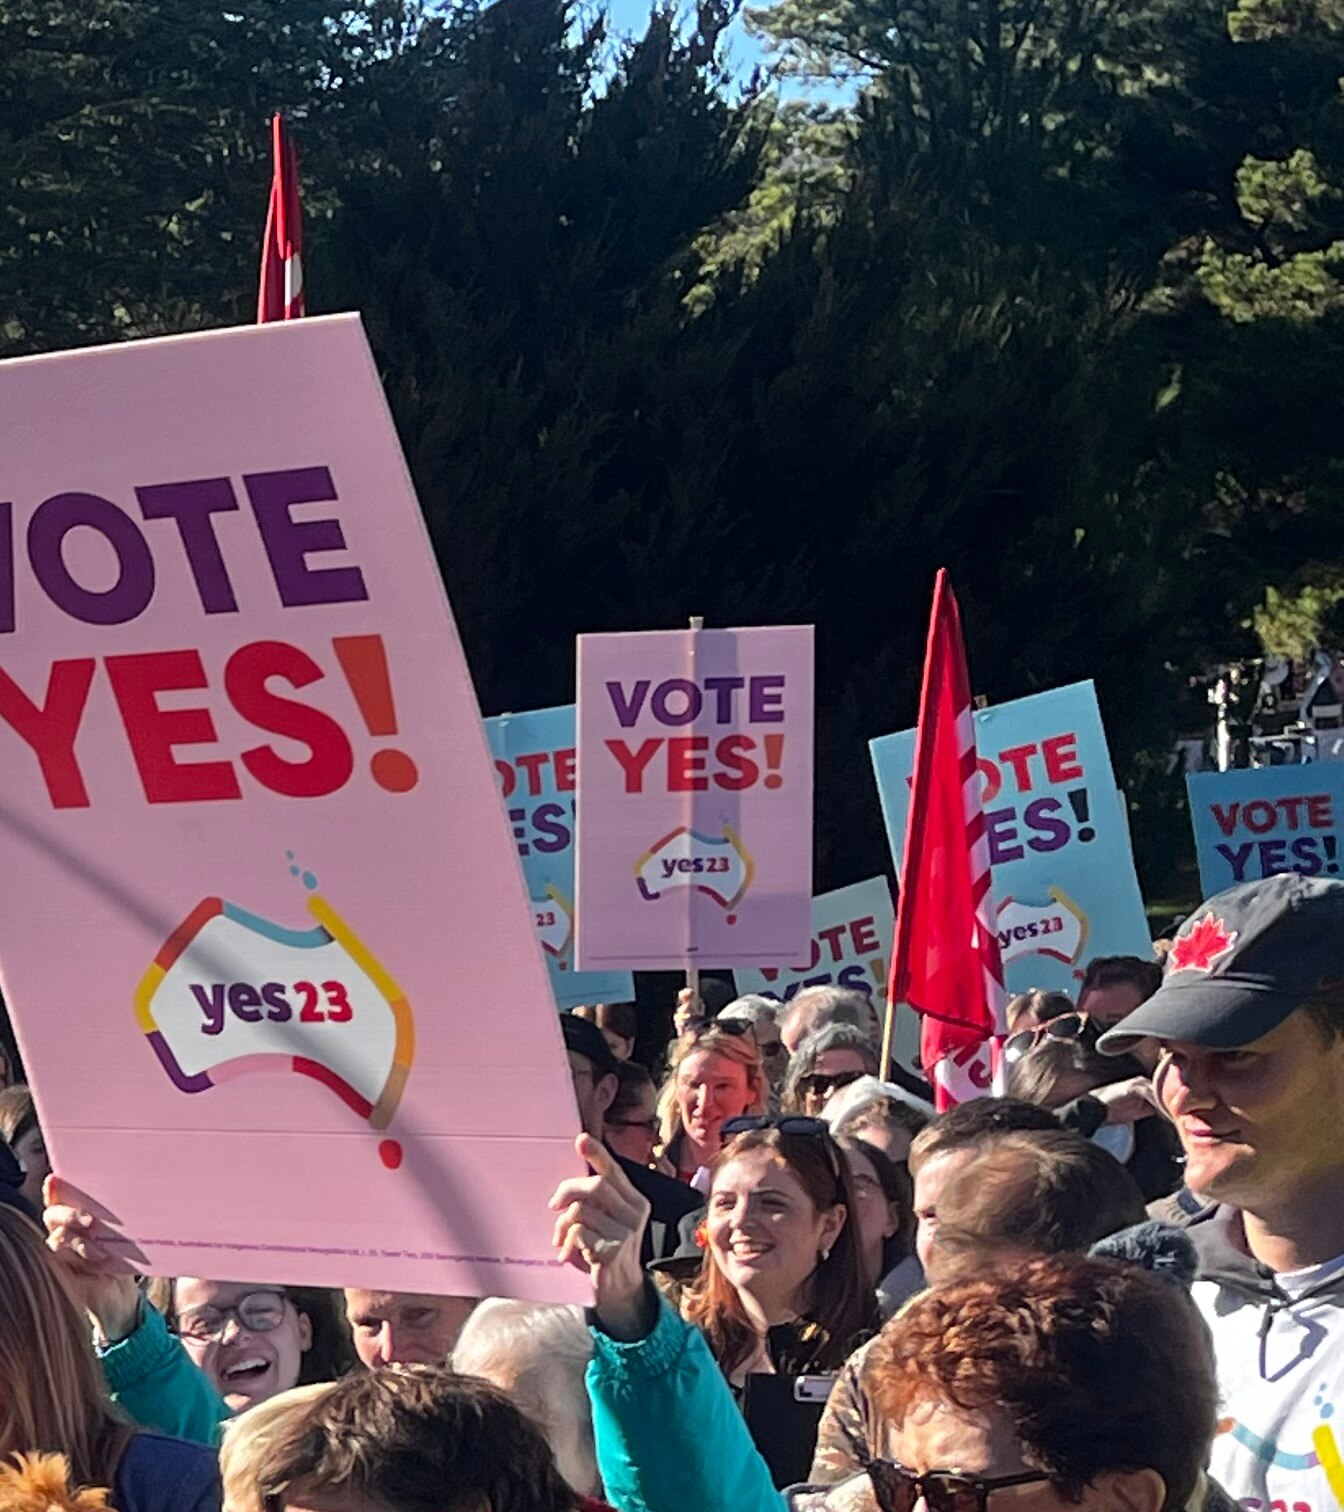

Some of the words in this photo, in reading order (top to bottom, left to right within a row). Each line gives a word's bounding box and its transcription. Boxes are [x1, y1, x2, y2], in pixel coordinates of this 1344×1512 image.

[605, 675, 785, 727] VOTE
[603, 734, 784, 793] YES!
[985, 788, 1095, 865] ES!
[1210, 794, 1333, 836] VOTE
[1215, 836, 1339, 881] YES!
[189, 979, 352, 1035] yes23
